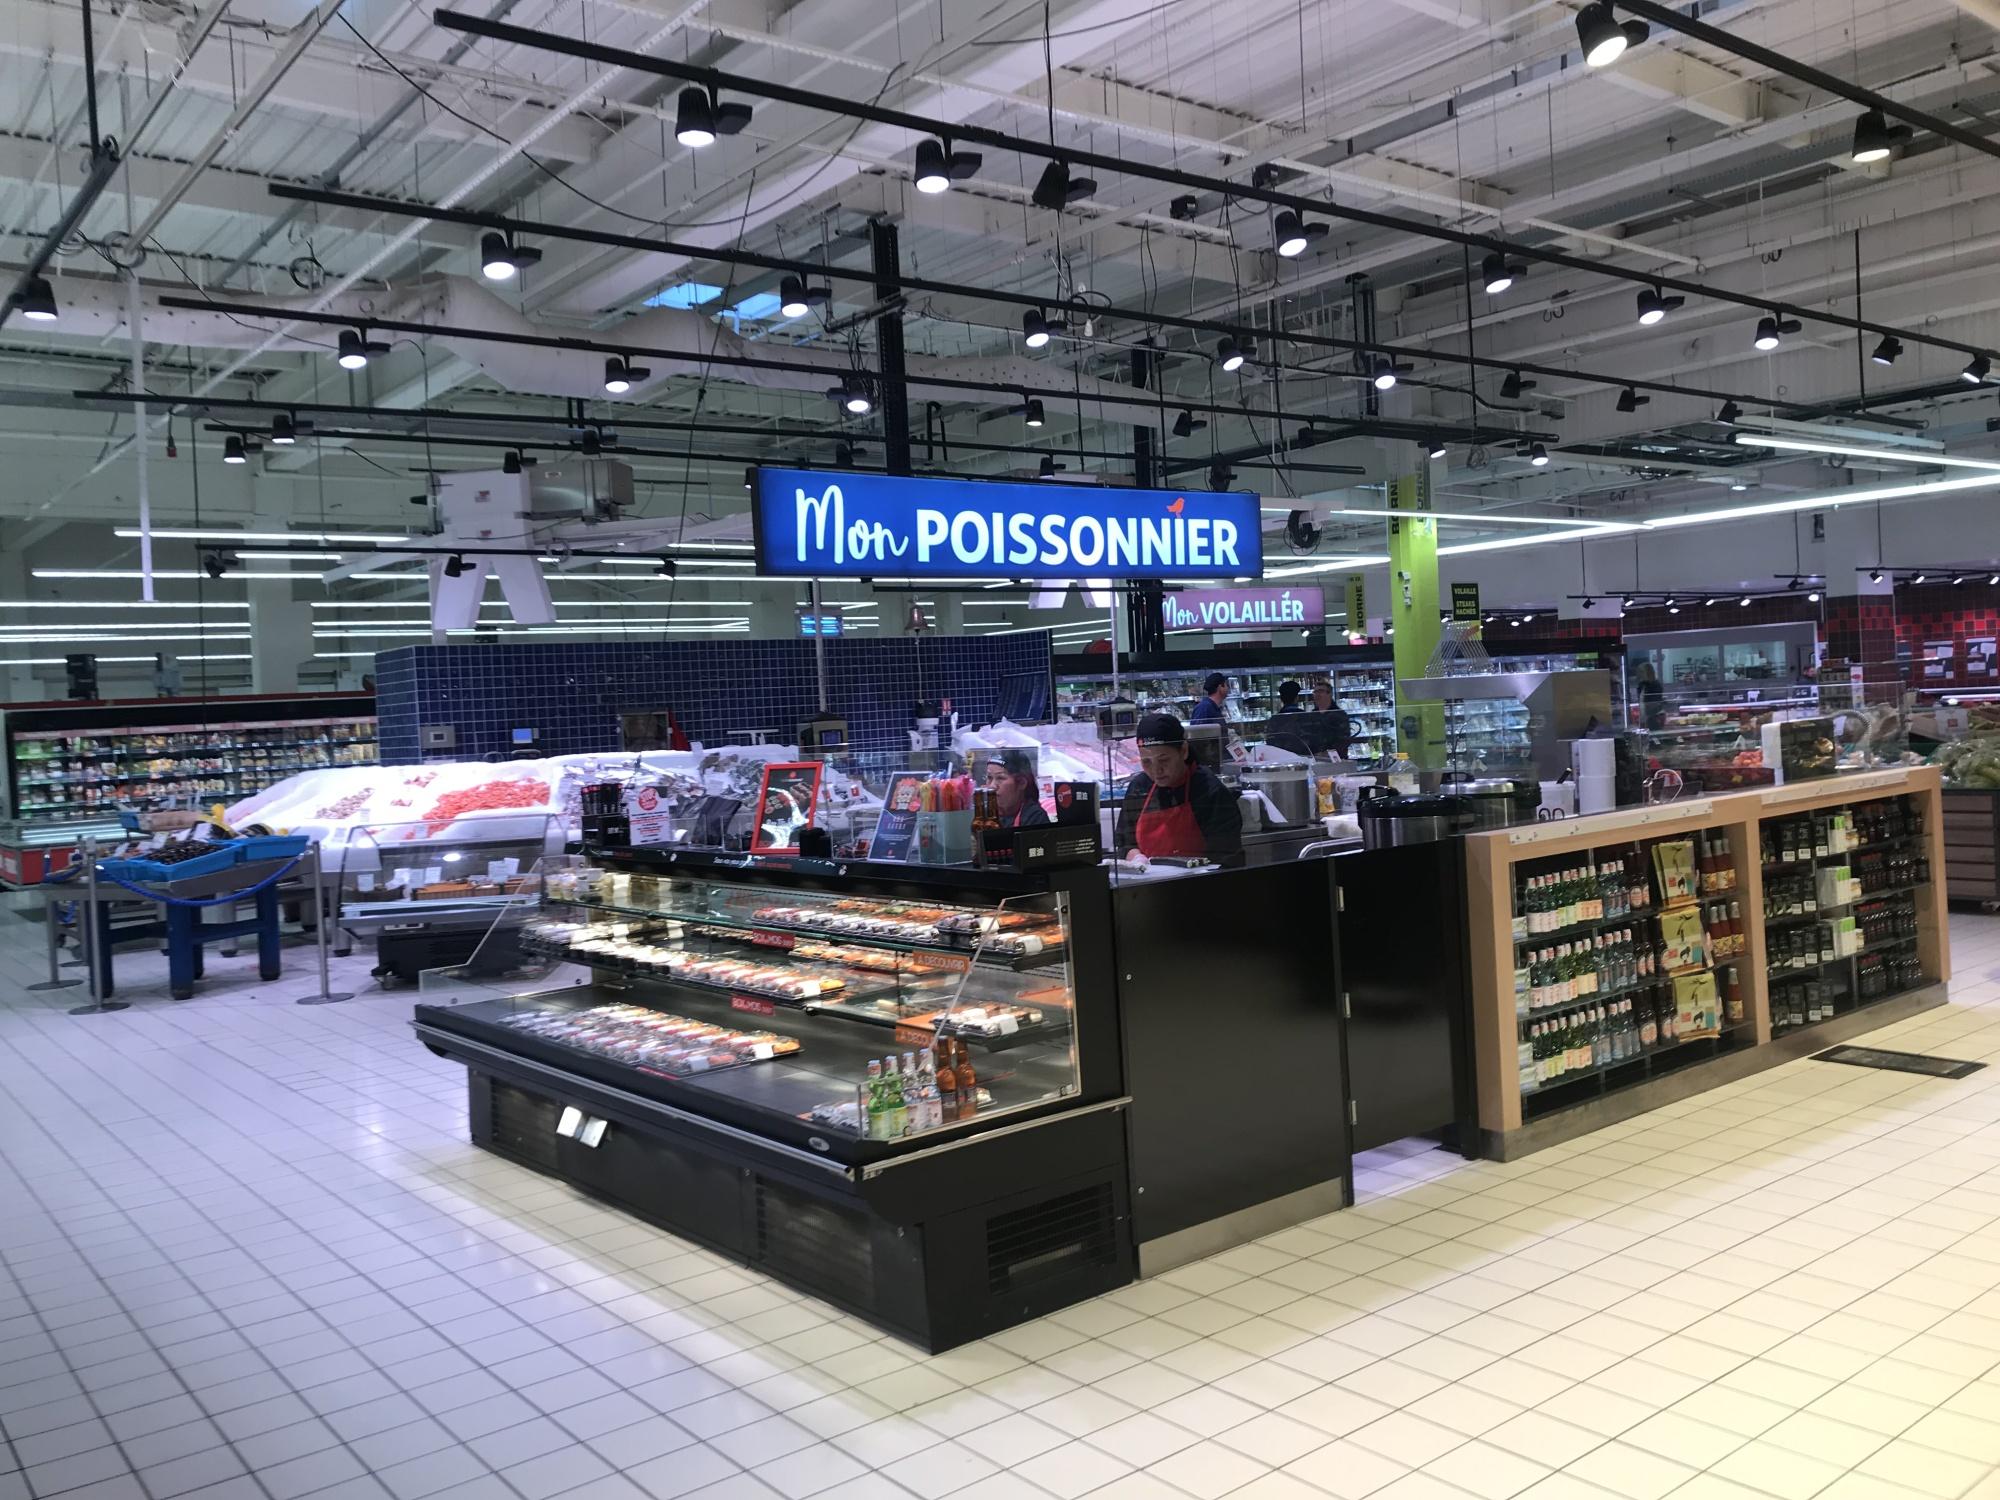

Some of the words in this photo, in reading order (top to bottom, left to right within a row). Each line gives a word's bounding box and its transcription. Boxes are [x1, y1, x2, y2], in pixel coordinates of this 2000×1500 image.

[795, 484, 909, 565] Mon
[917, 508, 1240, 566] POISSONNIER
[1163, 595, 1199, 628] Mon
[1356, 585, 1364, 628] BORNE
